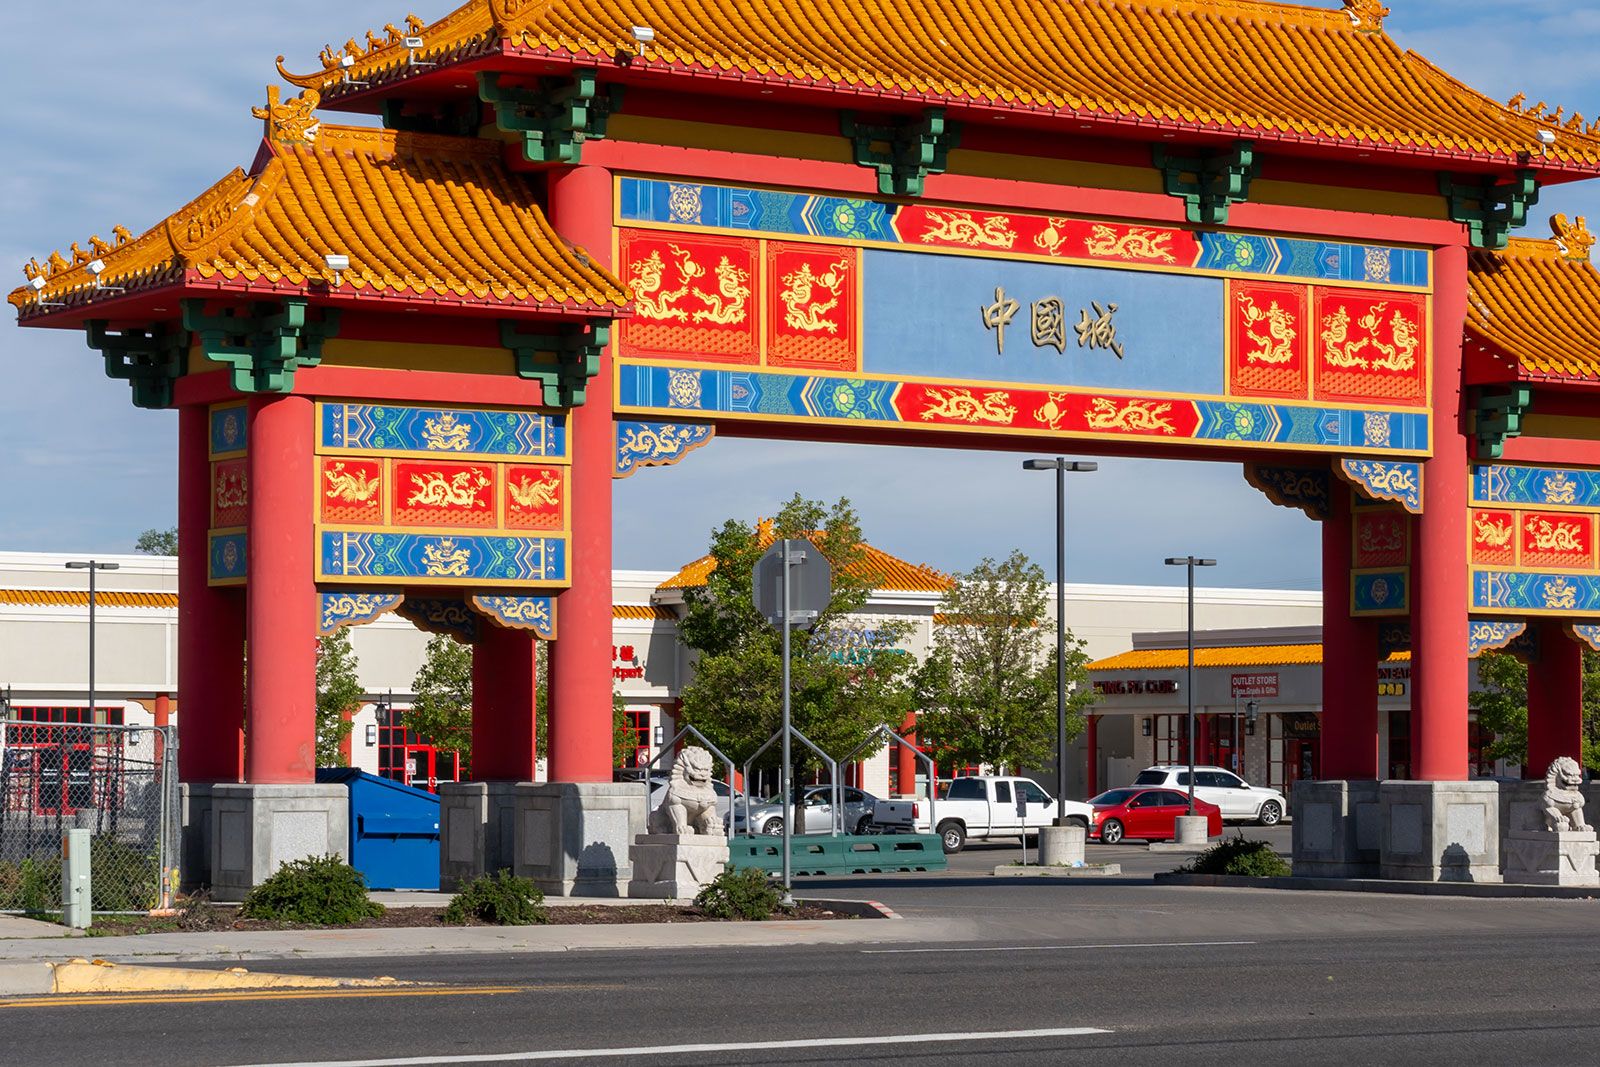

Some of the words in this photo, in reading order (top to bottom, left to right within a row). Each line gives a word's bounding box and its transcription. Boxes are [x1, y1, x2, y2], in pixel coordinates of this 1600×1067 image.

[981, 286, 1124, 360] 中國城
[612, 666, 643, 682] tpot
[1232, 676, 1256, 686] OUTLET
[1256, 675, 1277, 685] STORE
[1295, 720, 1316, 730] Outlet
